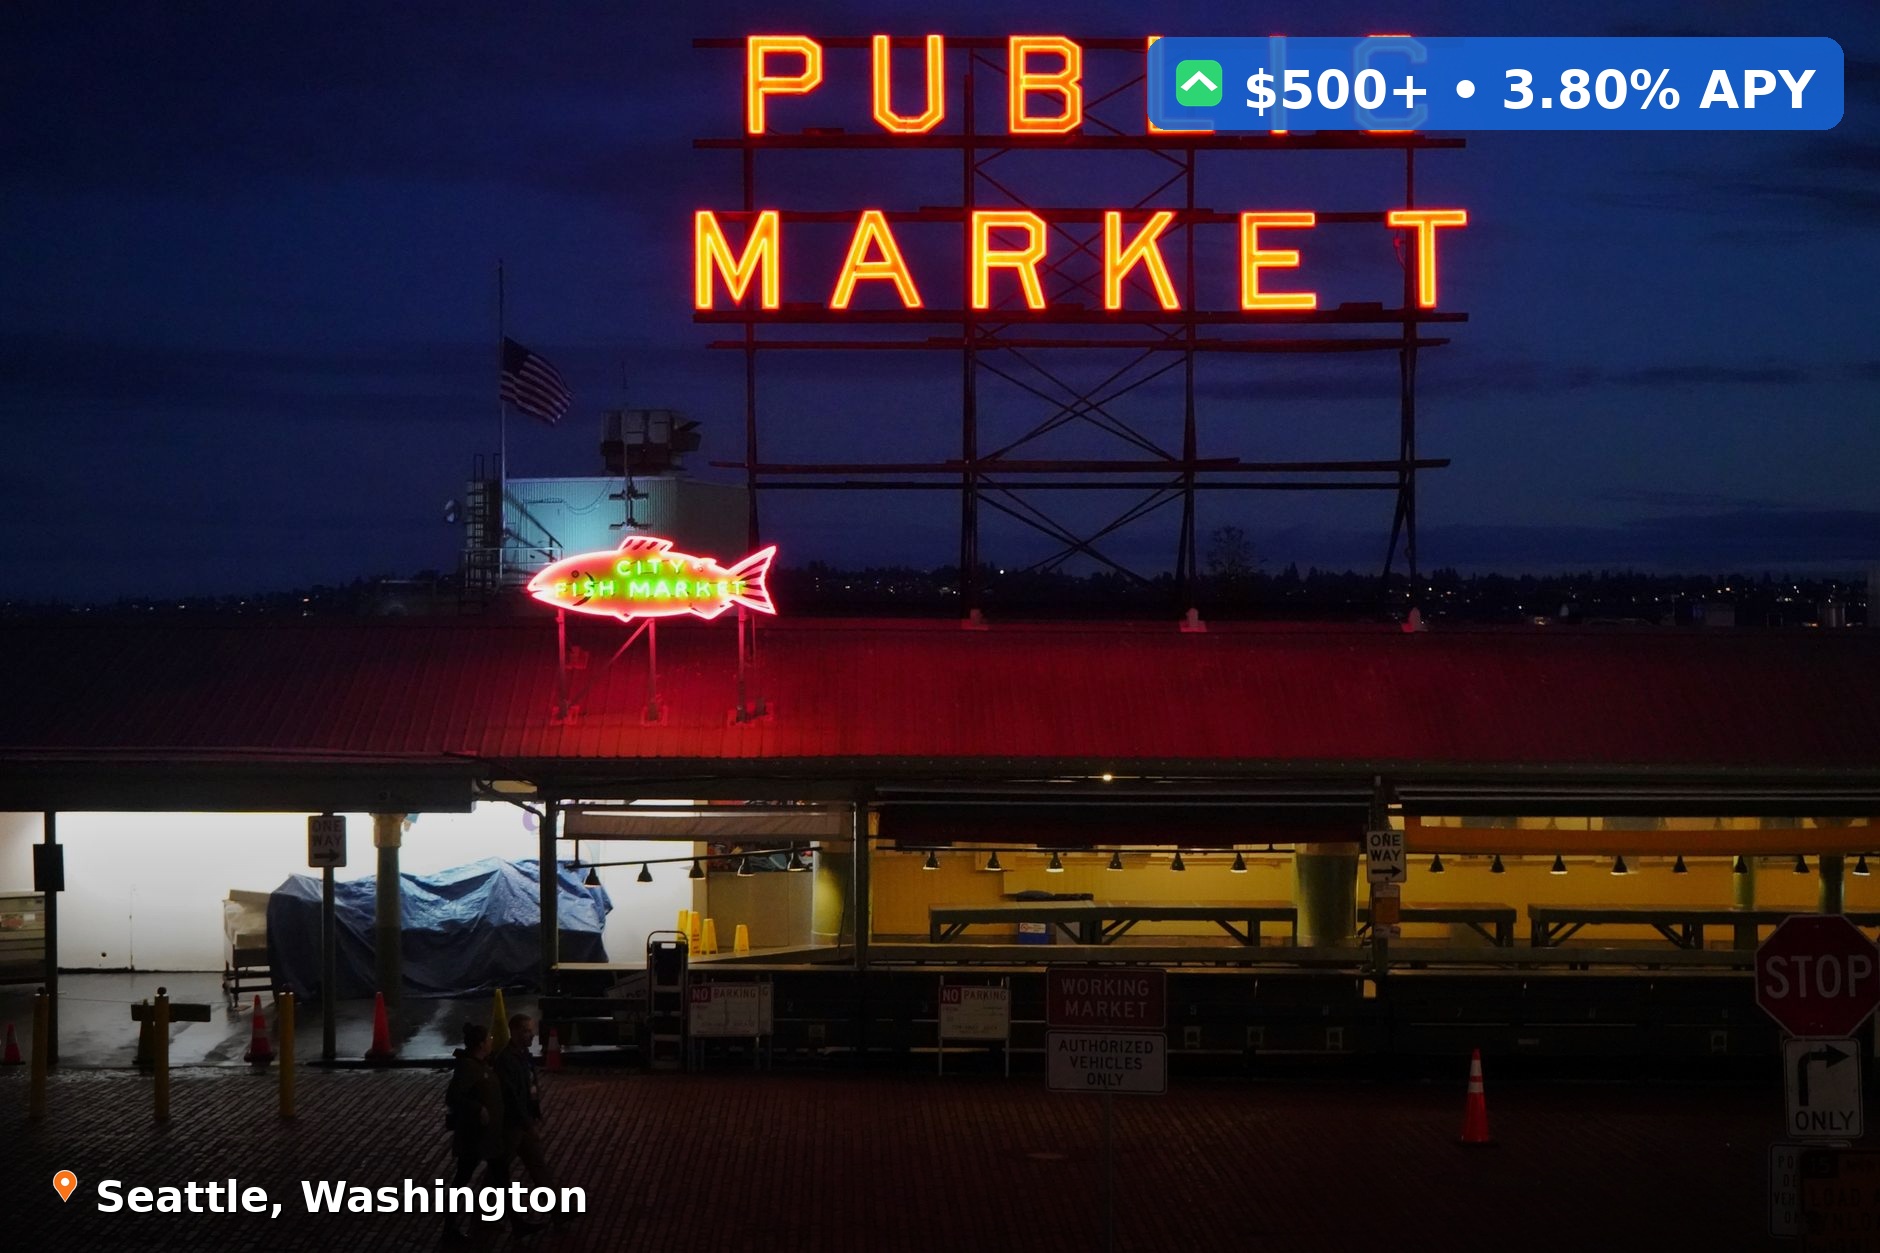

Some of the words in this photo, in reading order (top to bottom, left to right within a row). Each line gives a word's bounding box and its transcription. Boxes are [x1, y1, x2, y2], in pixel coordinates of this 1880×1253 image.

[694, 210, 1468, 310] MARKET
[616, 559, 686, 576] CITY
[554, 581, 615, 598] FISH
[629, 580, 747, 598] MARKET
[312, 820, 342, 832] ONE
[312, 834, 342, 847] WAY
[1370, 834, 1401, 847] ONE
[1370, 850, 1401, 862] WAY
[1765, 953, 1873, 999] STOP
[692, 987, 709, 1001] NO
[713, 988, 757, 999] PARKING
[942, 988, 960, 1002] NO
[963, 990, 1007, 1000] PARKING
[1060, 978, 1149, 997] WORKING
[1064, 1000, 1149, 1019] MARKET
[1058, 1039, 1154, 1054] AUTHORIZED
[1069, 1056, 1143, 1070] VEHICLES
[1087, 1072, 1124, 1086] ONLY
[1795, 1111, 1855, 1131] ONLY
[1811, 1187, 1861, 1207] LOAD
